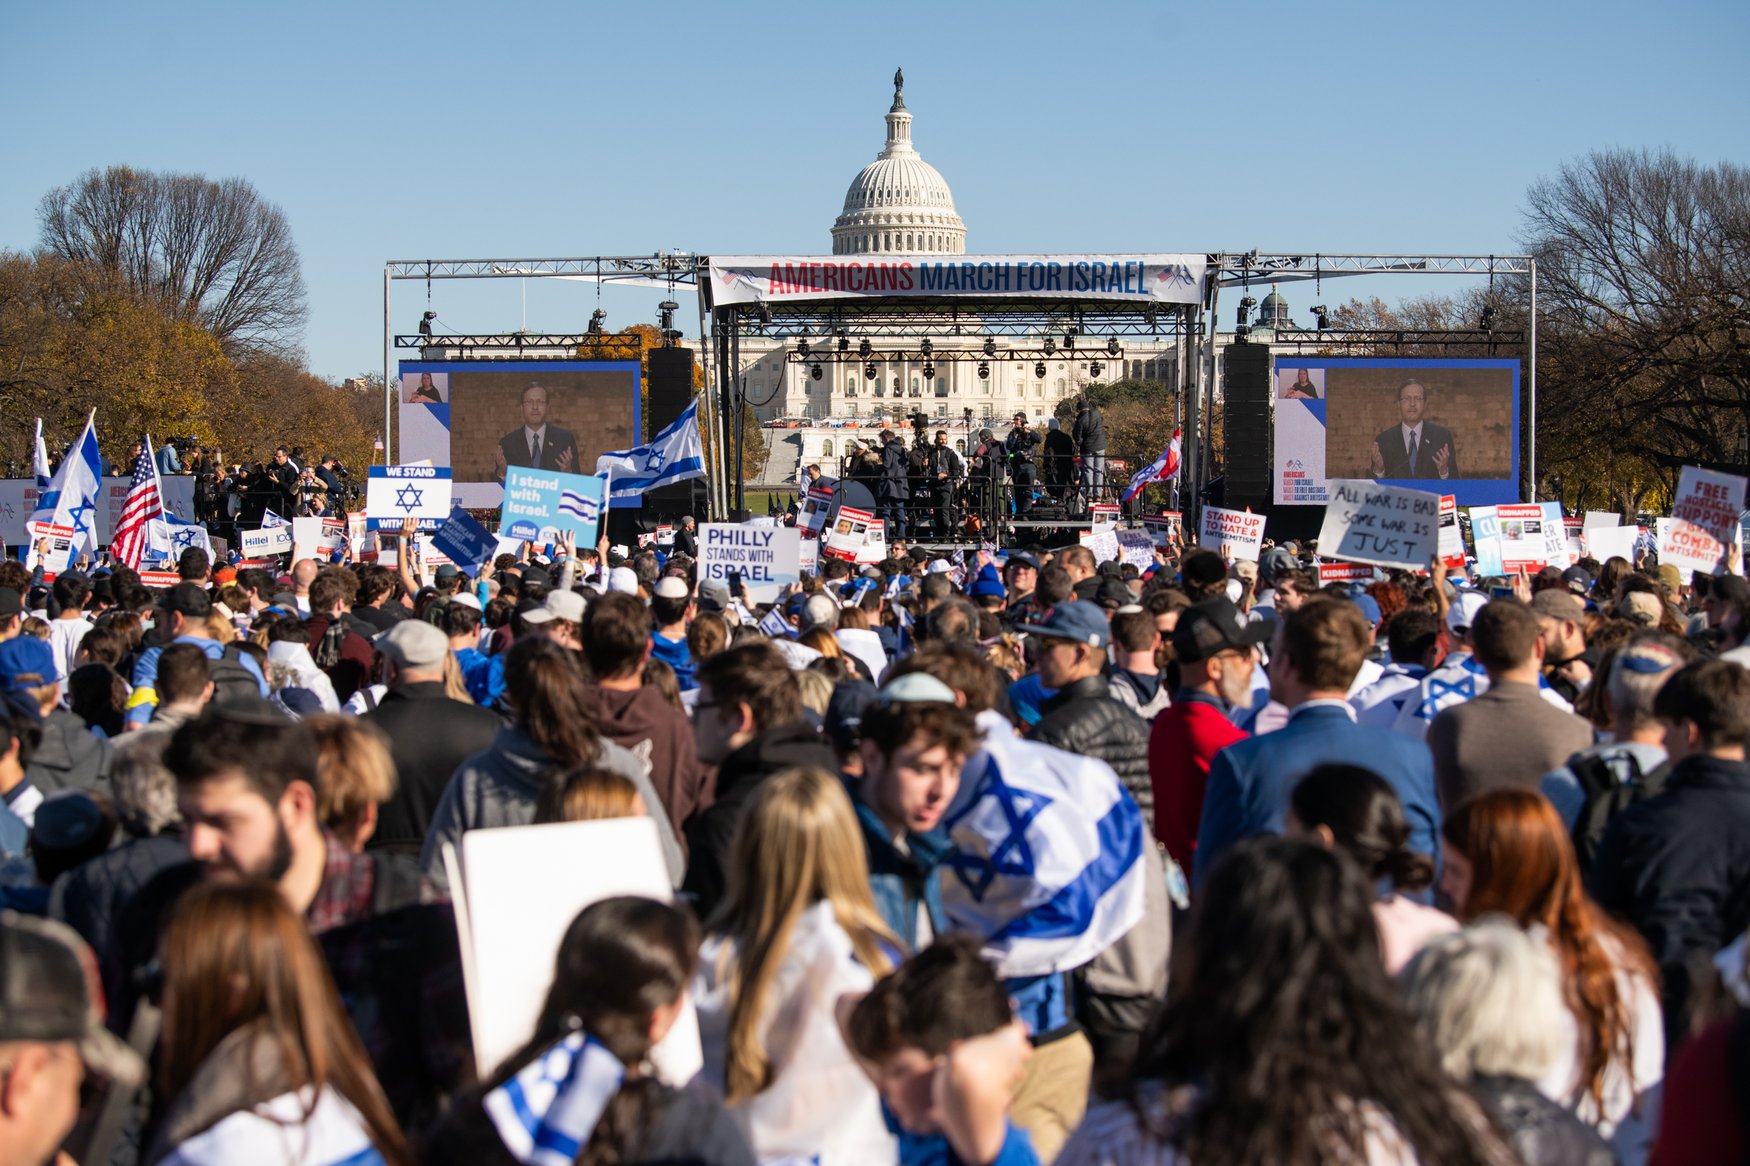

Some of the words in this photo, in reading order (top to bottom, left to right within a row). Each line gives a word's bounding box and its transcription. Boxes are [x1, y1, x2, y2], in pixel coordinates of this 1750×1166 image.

[769, 262, 914, 294] AMERICANS
[920, 262, 1010, 291] MARCH
[1016, 262, 1062, 291] FOR
[1068, 261, 1149, 295] ISRAEL
[386, 467, 403, 477] WE
[403, 467, 436, 477] STAND
[511, 473, 517, 486] I
[519, 475, 559, 490] stand
[1694, 480, 1728, 500] FREE
[510, 488, 541, 503] with
[1335, 486, 1361, 504] ALL
[1365, 493, 1392, 510] WAR
[1395, 496, 1407, 510] IS
[1413, 500, 1436, 516] BAD
[508, 501, 550, 518] Israel.
[1498, 509, 1541, 517] KIDNAPPED
[1673, 503, 1739, 530] SUPPORT
[378, 519, 402, 529] WITH
[1206, 511, 1242, 524] STAND
[1244, 517, 1260, 527] UP
[1340, 510, 1376, 527] SOME
[1380, 519, 1406, 533] WAR
[1412, 521, 1429, 536] IS
[1204, 530, 1256, 544] ANTISEMITISM
[1206, 520, 1218, 529] TO
[1220, 523, 1248, 535] HATE
[1250, 528, 1257, 537] &
[244, 535, 269, 546] Hillel
[708, 529, 774, 547] PHILLY
[1351, 531, 1418, 560] JUST
[1672, 529, 1721, 553] COMBA
[706, 547, 746, 561] STANDS
[748, 549, 774, 563] WITH
[140, 575, 181, 584] KIDNAPPED
[705, 563, 774, 582] ISRAEL
[1322, 568, 1371, 578] KIDNAPPED
